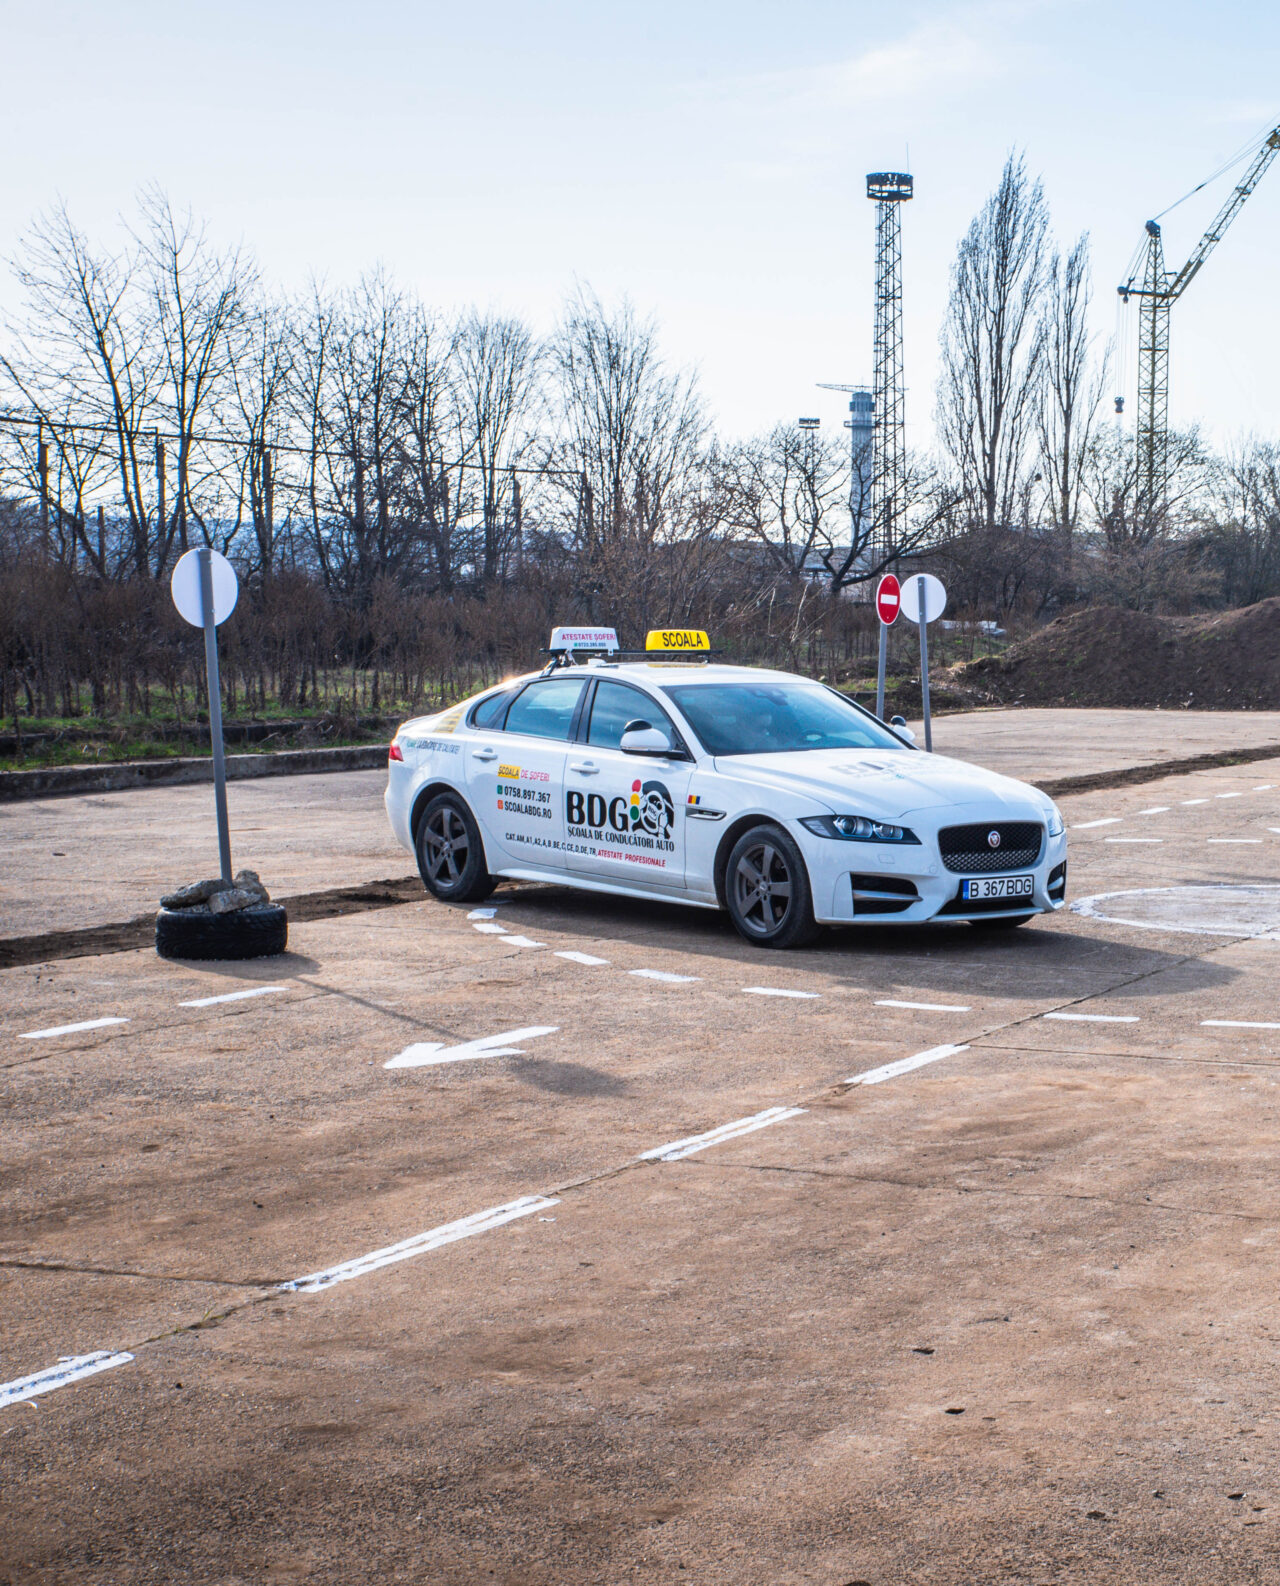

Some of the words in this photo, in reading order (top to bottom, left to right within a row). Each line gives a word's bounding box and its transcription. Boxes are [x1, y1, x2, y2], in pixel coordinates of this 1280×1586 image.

[662, 632, 704, 648] SCOALA
[520, 769, 528, 778] DE
[504, 785, 551, 804] 0758.897.367
[504, 800, 552, 820] SCOALABDG.RO
[566, 790, 629, 832] BDG
[594, 830, 604, 840] DE
[605, 832, 654, 848] CONDUCĂTORI
[656, 840, 674, 852] AUTO
[624, 854, 666, 868] PROFESIONALE
[970, 882, 979, 898] B
